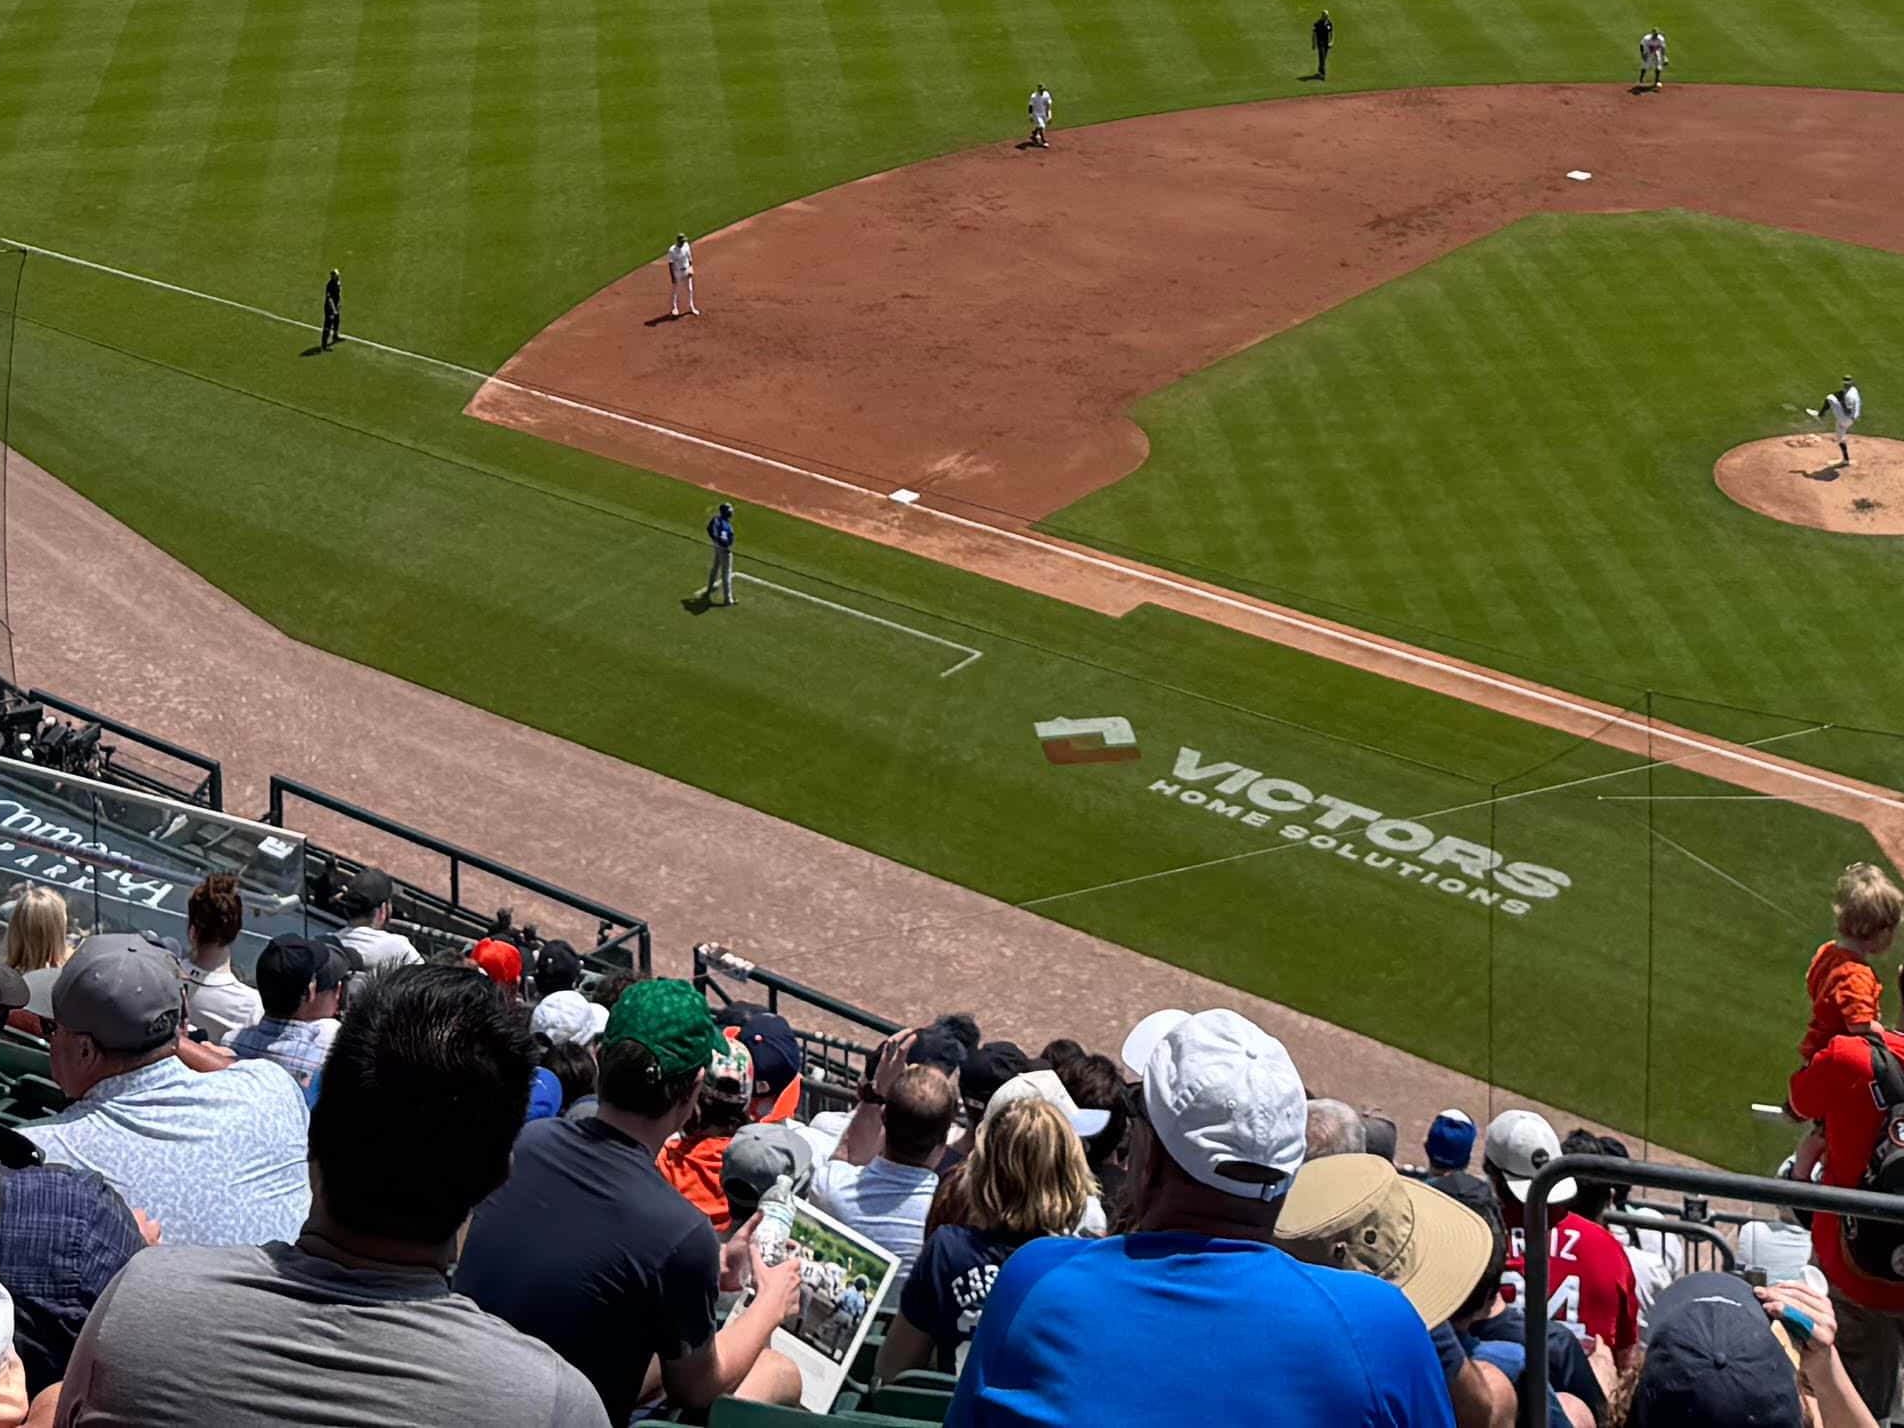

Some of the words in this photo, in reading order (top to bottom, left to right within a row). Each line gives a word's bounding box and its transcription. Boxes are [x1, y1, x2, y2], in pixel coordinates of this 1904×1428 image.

[1148, 778, 1271, 828] HOME
[1279, 824, 1532, 916] SOLUTIONS
[1172, 746, 1572, 899] VICTORS
